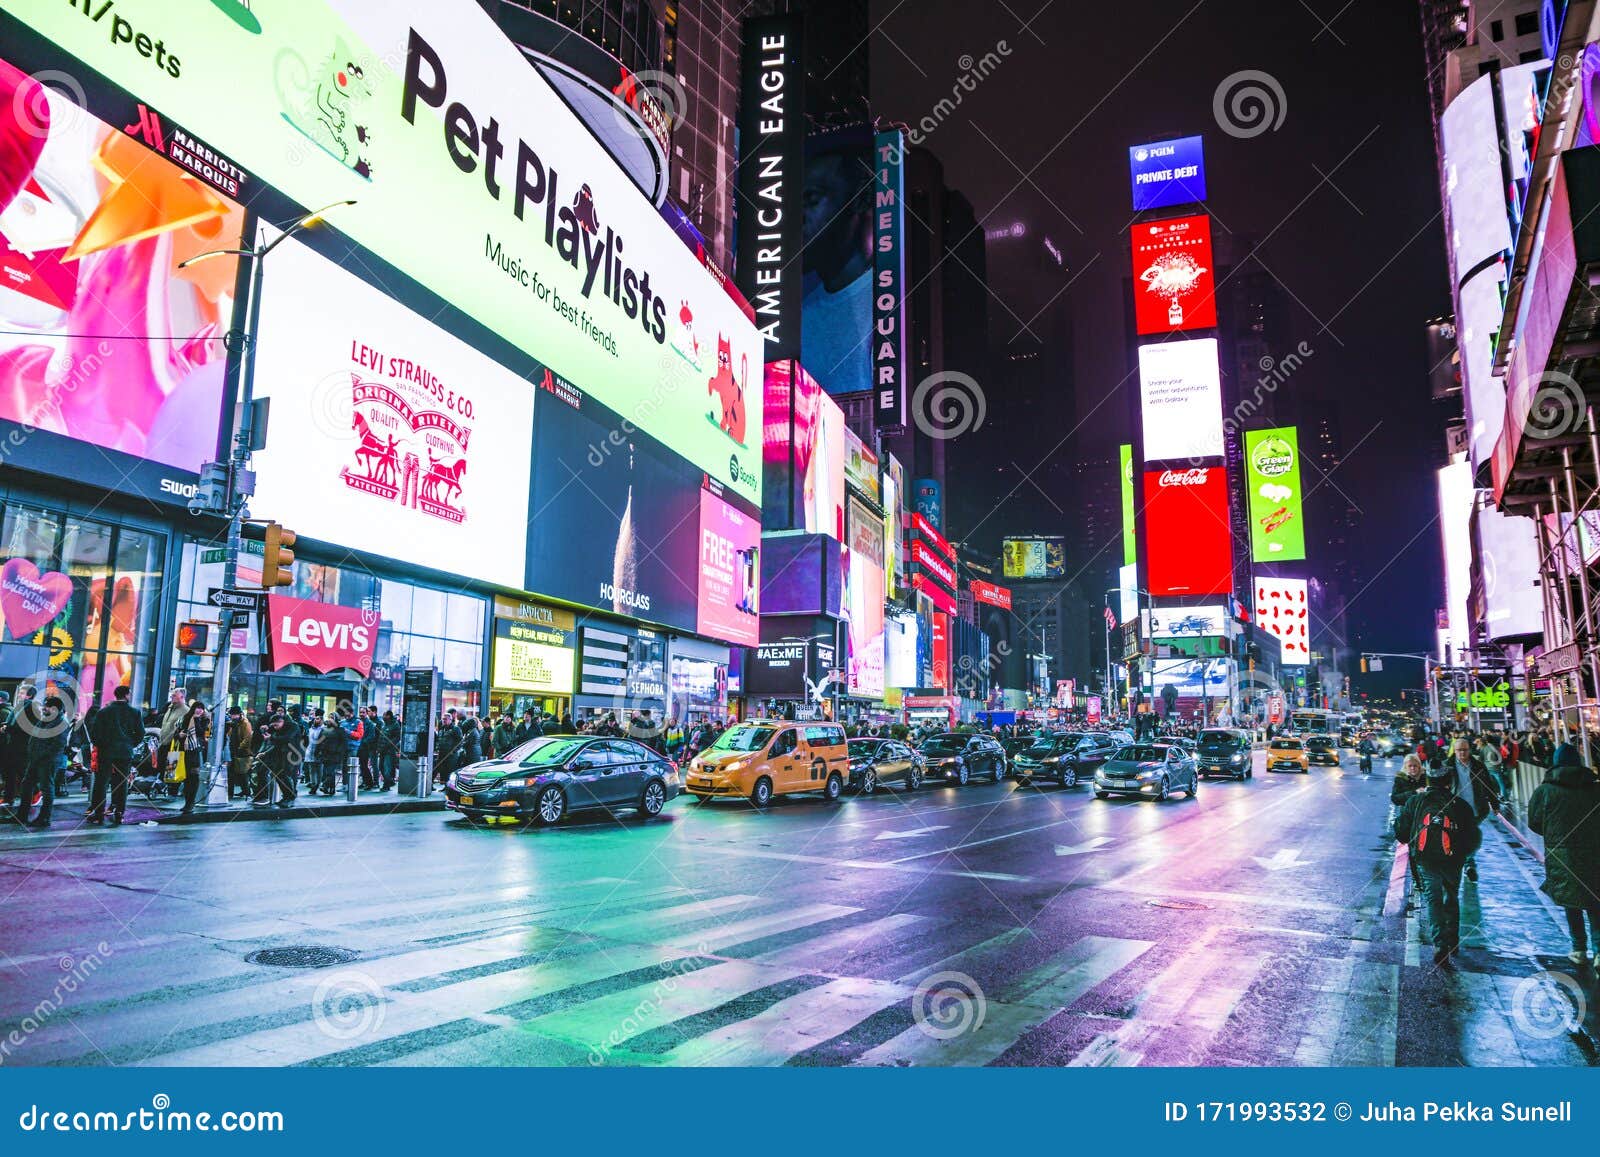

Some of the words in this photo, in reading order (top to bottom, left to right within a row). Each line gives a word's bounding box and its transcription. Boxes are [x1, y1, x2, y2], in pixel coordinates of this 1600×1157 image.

[760, 34, 785, 134] EAGLE
[173, 130, 247, 184] MARRIOTT
[1150, 146, 1175, 157] PGIM
[172, 146, 237, 194] MARQUIS
[1136, 170, 1173, 184] PRIVATE
[1174, 165, 1198, 179] DEBT
[401, 26, 503, 200] Pet
[514, 138, 666, 345] Playlists
[876, 146, 895, 253] TIMES
[755, 156, 784, 343] AMERICAN
[485, 234, 529, 287] Music
[533, 272, 551, 303] for
[553, 287, 578, 326] best
[581, 311, 619, 358] friends.
[877, 270, 896, 409] SQUARE
[352, 340, 383, 374] LEVI
[389, 357, 445, 403] STRAUSS
[447, 390, 455, 410] &
[457, 396, 475, 420] CO.
[354, 387, 415, 425] ORIGINAL
[417, 414, 467, 444] RIVETED
[370, 408, 400, 430] QUALITY
[425, 433, 455, 455] CLOTHING
[1258, 456, 1291, 465] Green
[1262, 464, 1291, 474] Giant
[740, 466, 757, 491] Spotify
[1159, 468, 1209, 486] Coca-Cola
[160, 478, 200, 498] swat
[349, 478, 393, 498] PATENTED
[212, 551, 222, 561] 45
[249, 541, 264, 553] Broa
[703, 528, 734, 573] FREE
[15, 574, 46, 593] HAPPY
[215, 594, 230, 602] ONE
[236, 595, 251, 605] WAY
[600, 582, 650, 610] HOURGLASS
[22, 600, 42, 614] DAY
[520, 603, 553, 622] INVICTA
[757, 648, 803, 659] #AExME
[375, 667, 391, 680] 501
[631, 682, 664, 695] SEPHORA
